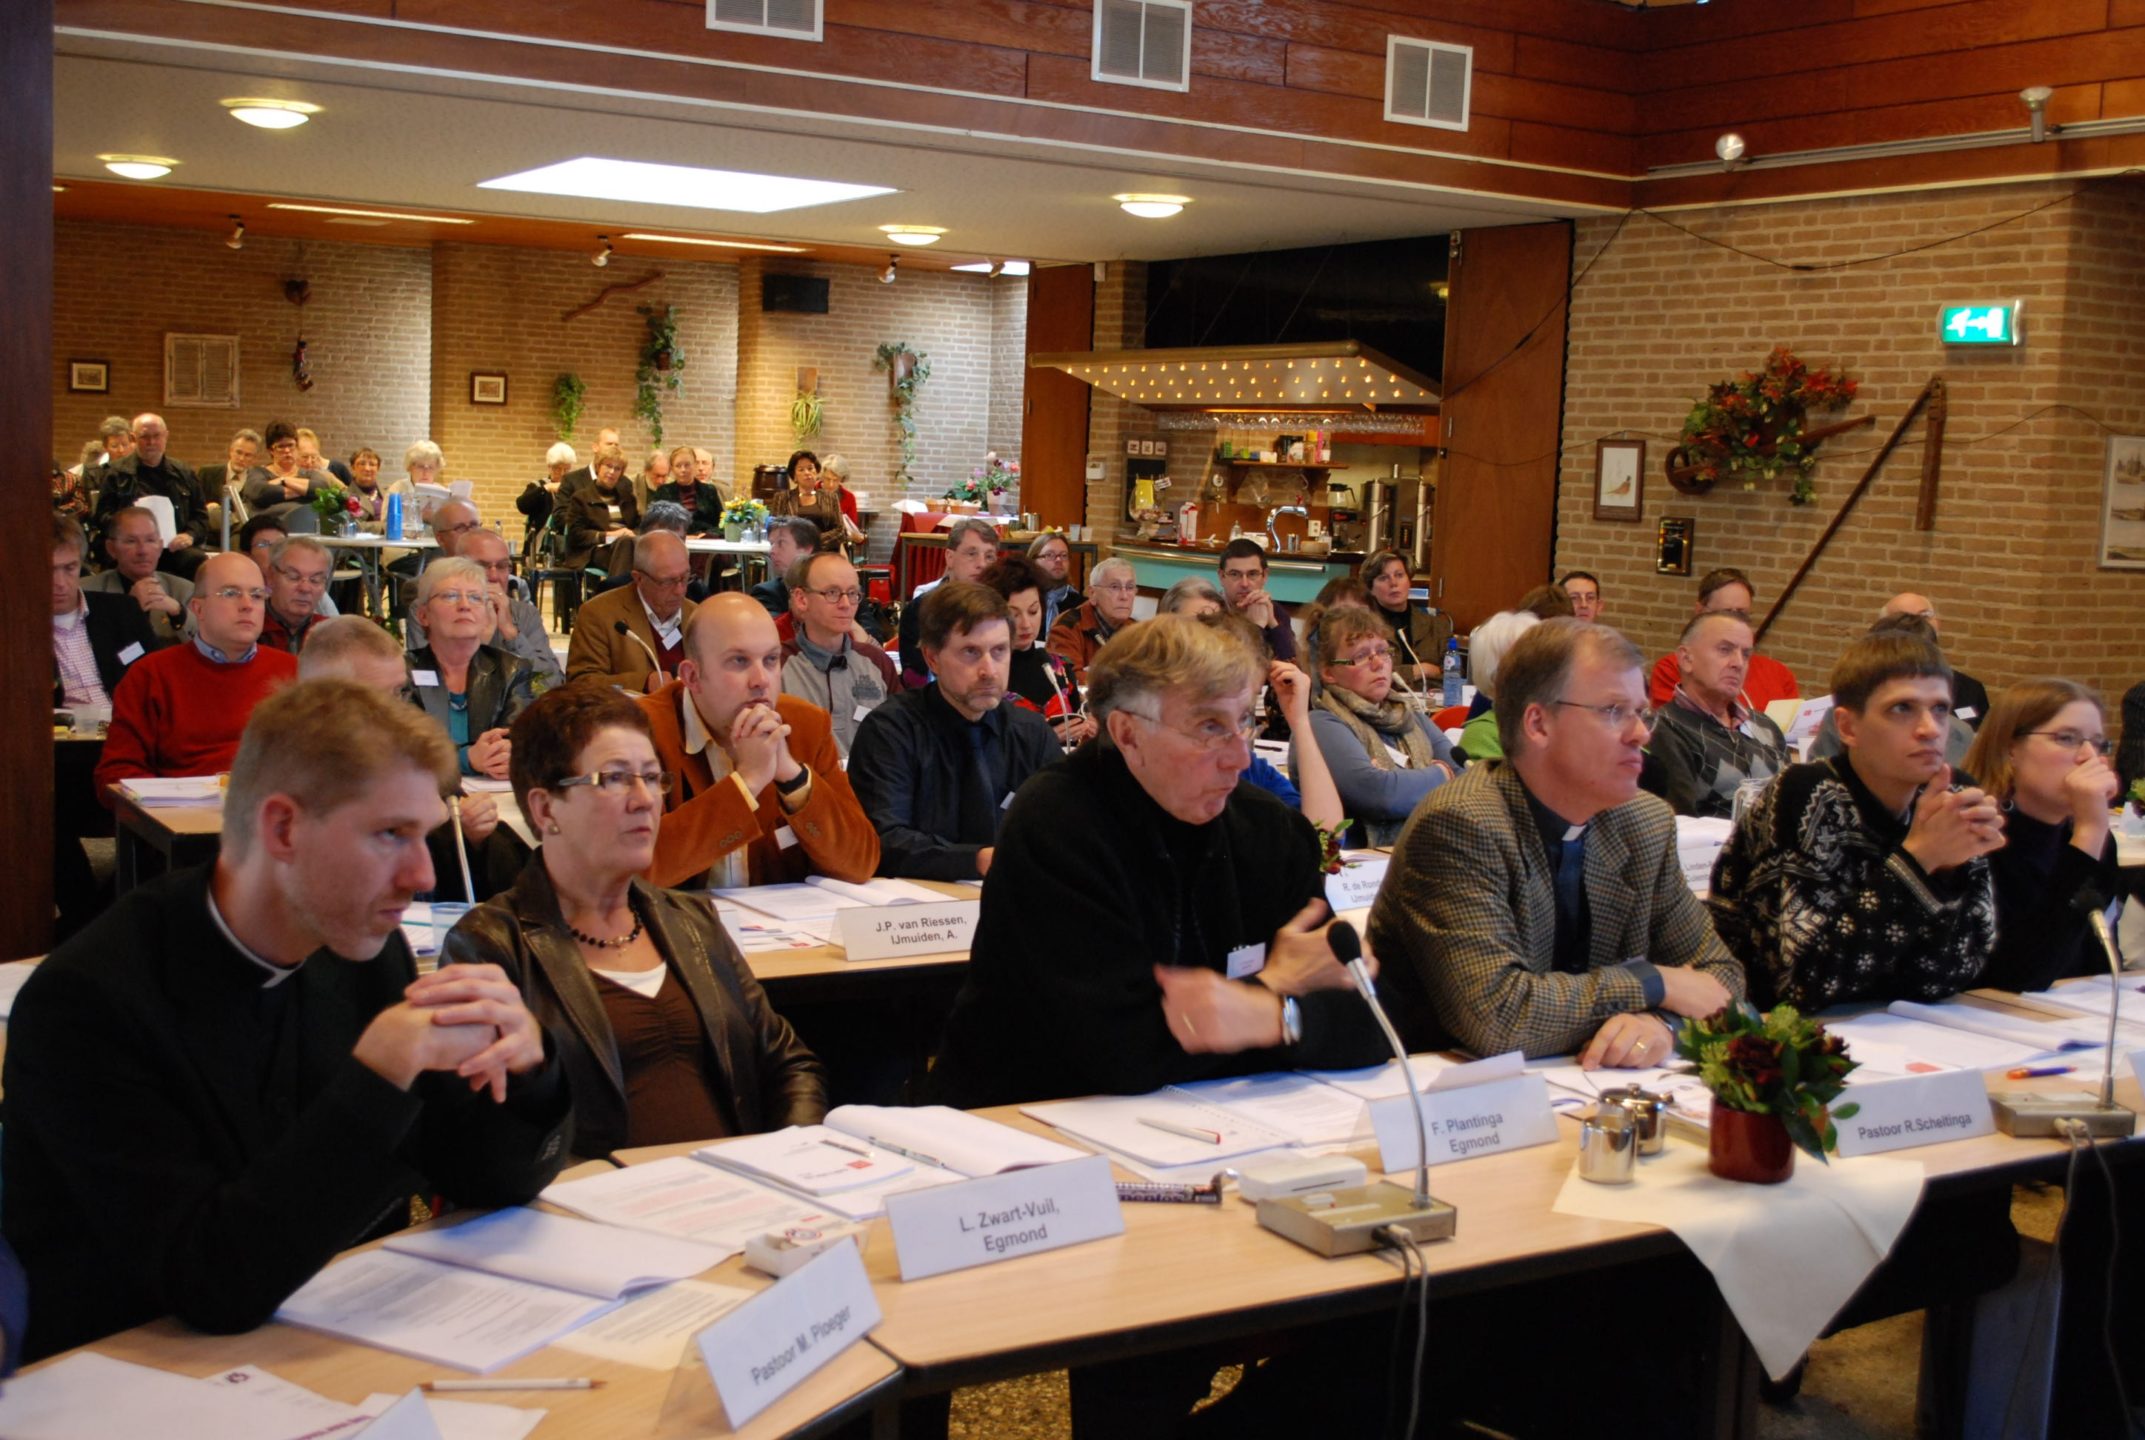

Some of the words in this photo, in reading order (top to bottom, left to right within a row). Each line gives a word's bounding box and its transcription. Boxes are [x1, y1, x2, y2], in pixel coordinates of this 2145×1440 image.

[876, 921, 897, 932] J.P.
[900, 920, 919, 930] van
[921, 916, 967, 927] Riessen,
[891, 933, 944, 945] IJmuiden,
[947, 930, 958, 939] A.
[1431, 1122, 1445, 1135] F.
[1447, 1112, 1504, 1133] Plantinga
[1858, 1124, 1902, 1140] Pastoor
[1449, 1133, 1500, 1154] Egmond
[959, 1215, 975, 1233] L.
[978, 1197, 1060, 1229] Zwart-Vuil,
[983, 1223, 1048, 1253] Egmond
[750, 1344, 796, 1387] Pastoor
[810, 1304, 851, 1343] Ploeger
